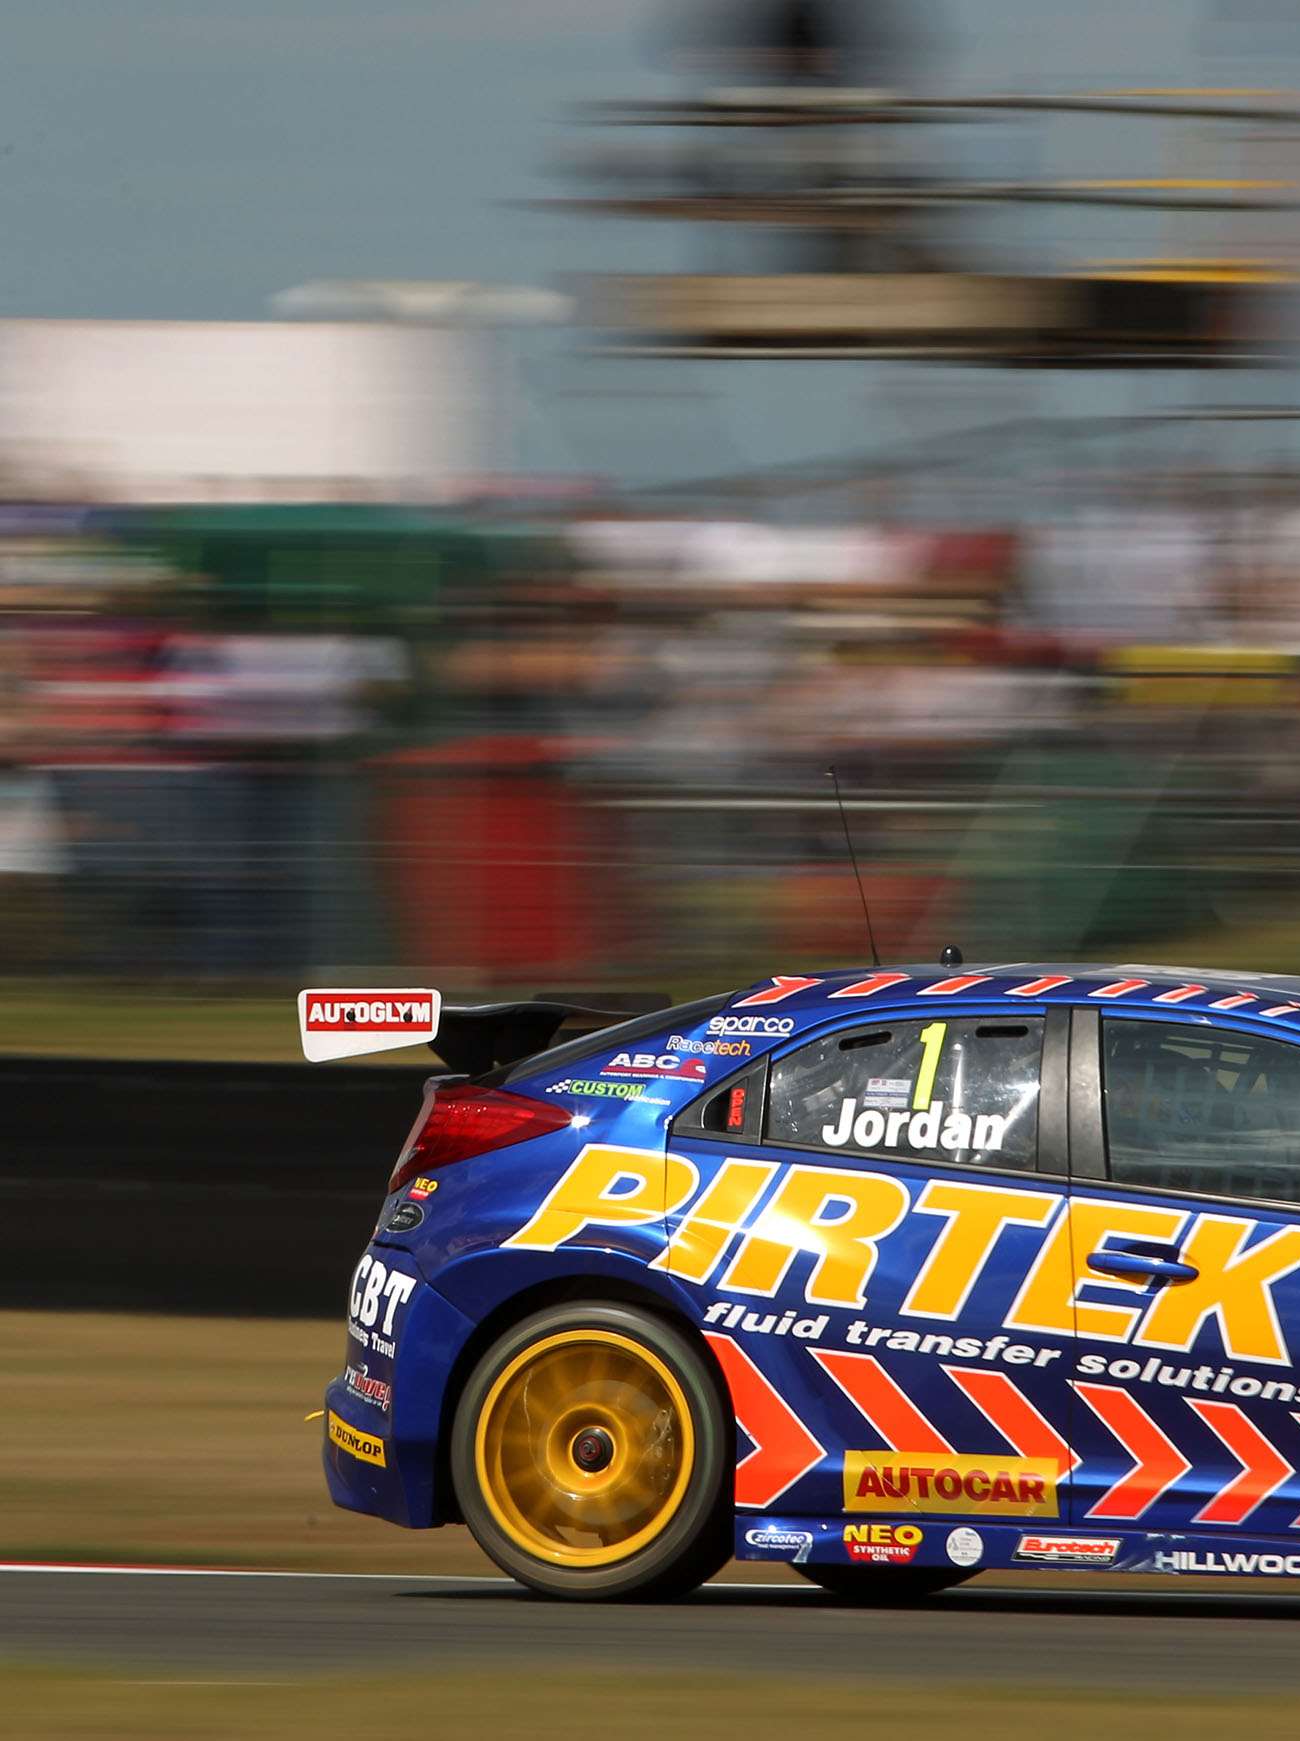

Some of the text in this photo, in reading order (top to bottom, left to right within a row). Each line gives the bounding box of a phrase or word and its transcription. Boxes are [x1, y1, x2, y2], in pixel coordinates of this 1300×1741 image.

[308, 1002, 431, 1023] AUTOGLYM
[709, 1016, 795, 1036] sparco
[665, 1036, 751, 1056] Racetech
[607, 1053, 681, 1070] ABC
[912, 1022, 948, 1111] 1
[571, 1080, 644, 1098] CUSTOM
[822, 1098, 1006, 1151] Jordan
[414, 1177, 438, 1193] NEO
[350, 1254, 418, 1337] CBT
[703, 1301, 829, 1341] fluid
[847, 1319, 1063, 1369] transfer
[336, 1426, 382, 1457] DUNLOP
[856, 1466, 1047, 1504] AUTOCAR
[842, 1525, 924, 1546] NEO
[853, 1545, 911, 1556] SYNTHETIC
[871, 1553, 890, 1562] OIL
